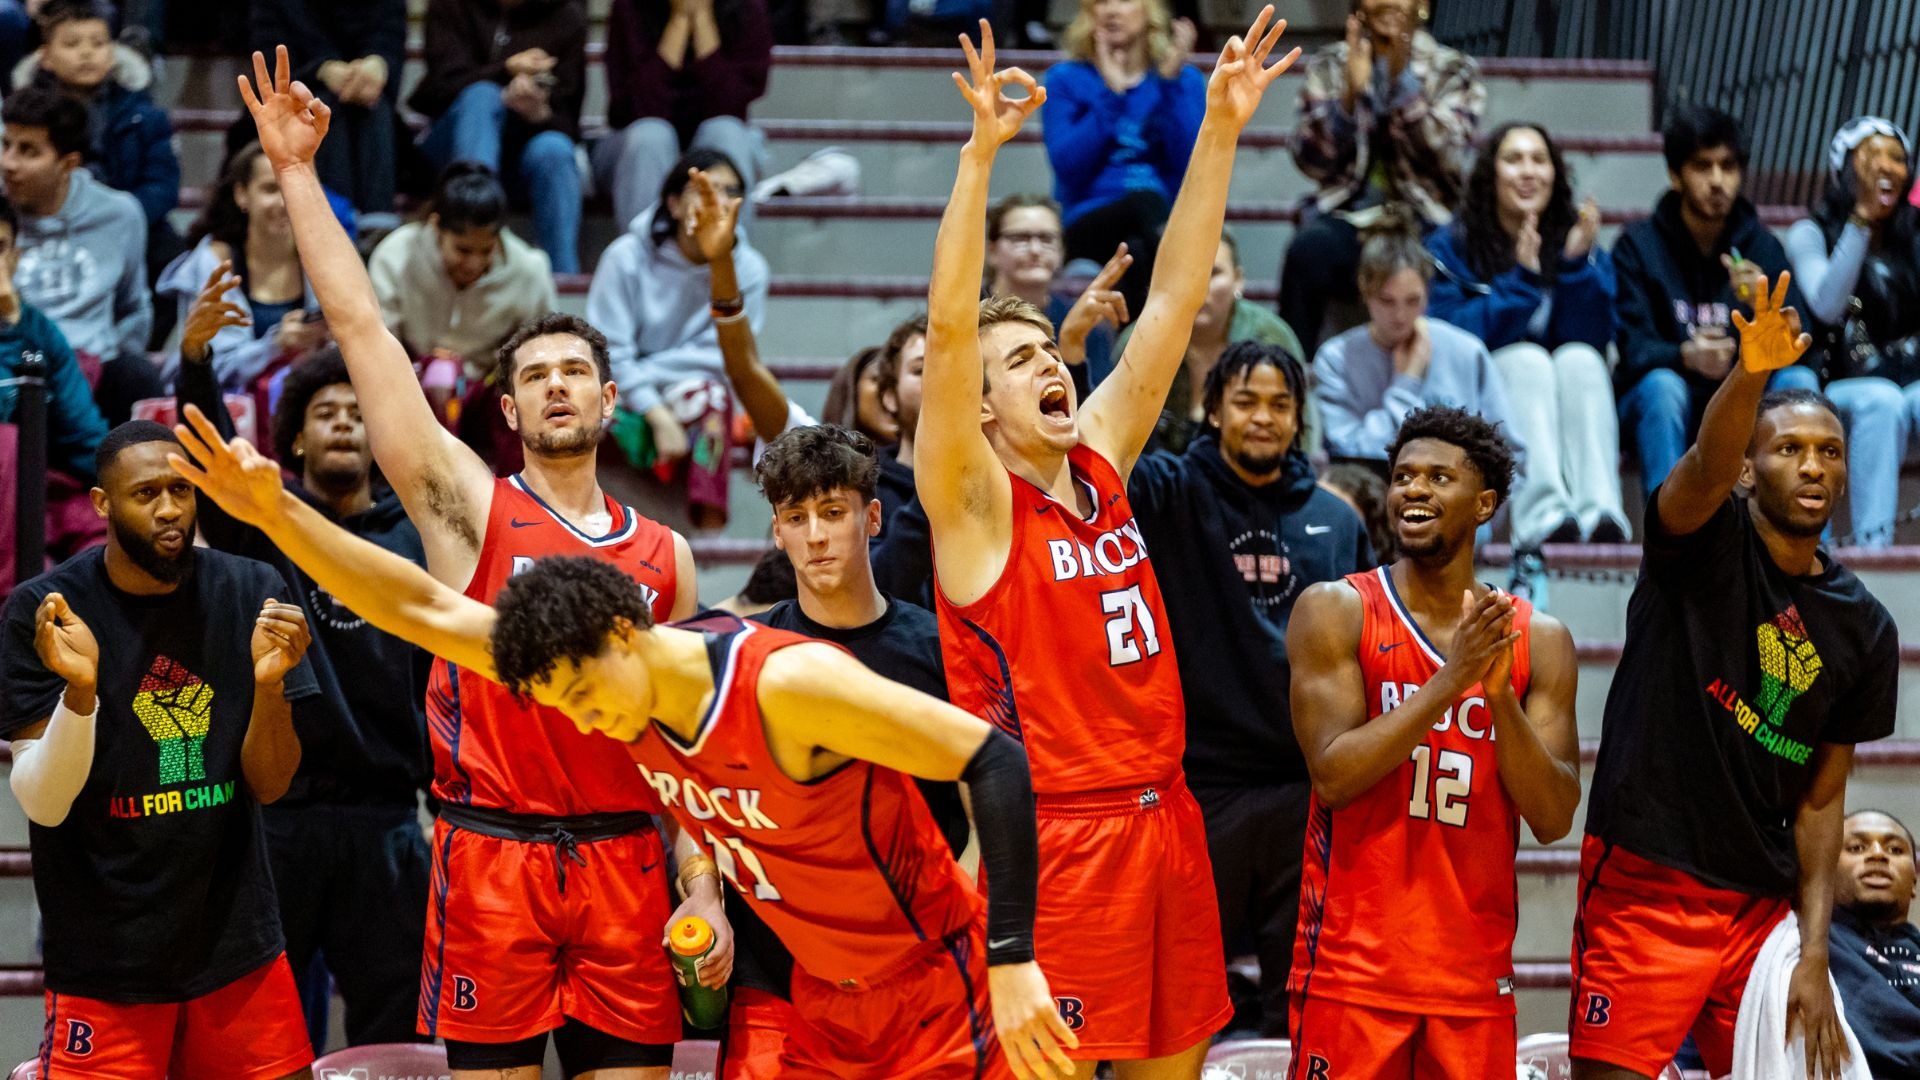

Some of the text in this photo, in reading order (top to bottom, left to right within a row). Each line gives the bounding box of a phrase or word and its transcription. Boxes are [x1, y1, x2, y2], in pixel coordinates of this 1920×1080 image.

[1100, 582, 1161, 667] 21
[1705, 678, 1813, 765] ALL FOR CHANGE
[110, 796, 141, 818] ALL
[142, 790, 182, 816] FOR
[1409, 743, 1474, 828] 12
[451, 974, 478, 1011] B
[1584, 991, 1612, 1027] B
[1054, 996, 1085, 1030] B
[64, 1018, 94, 1057] B
